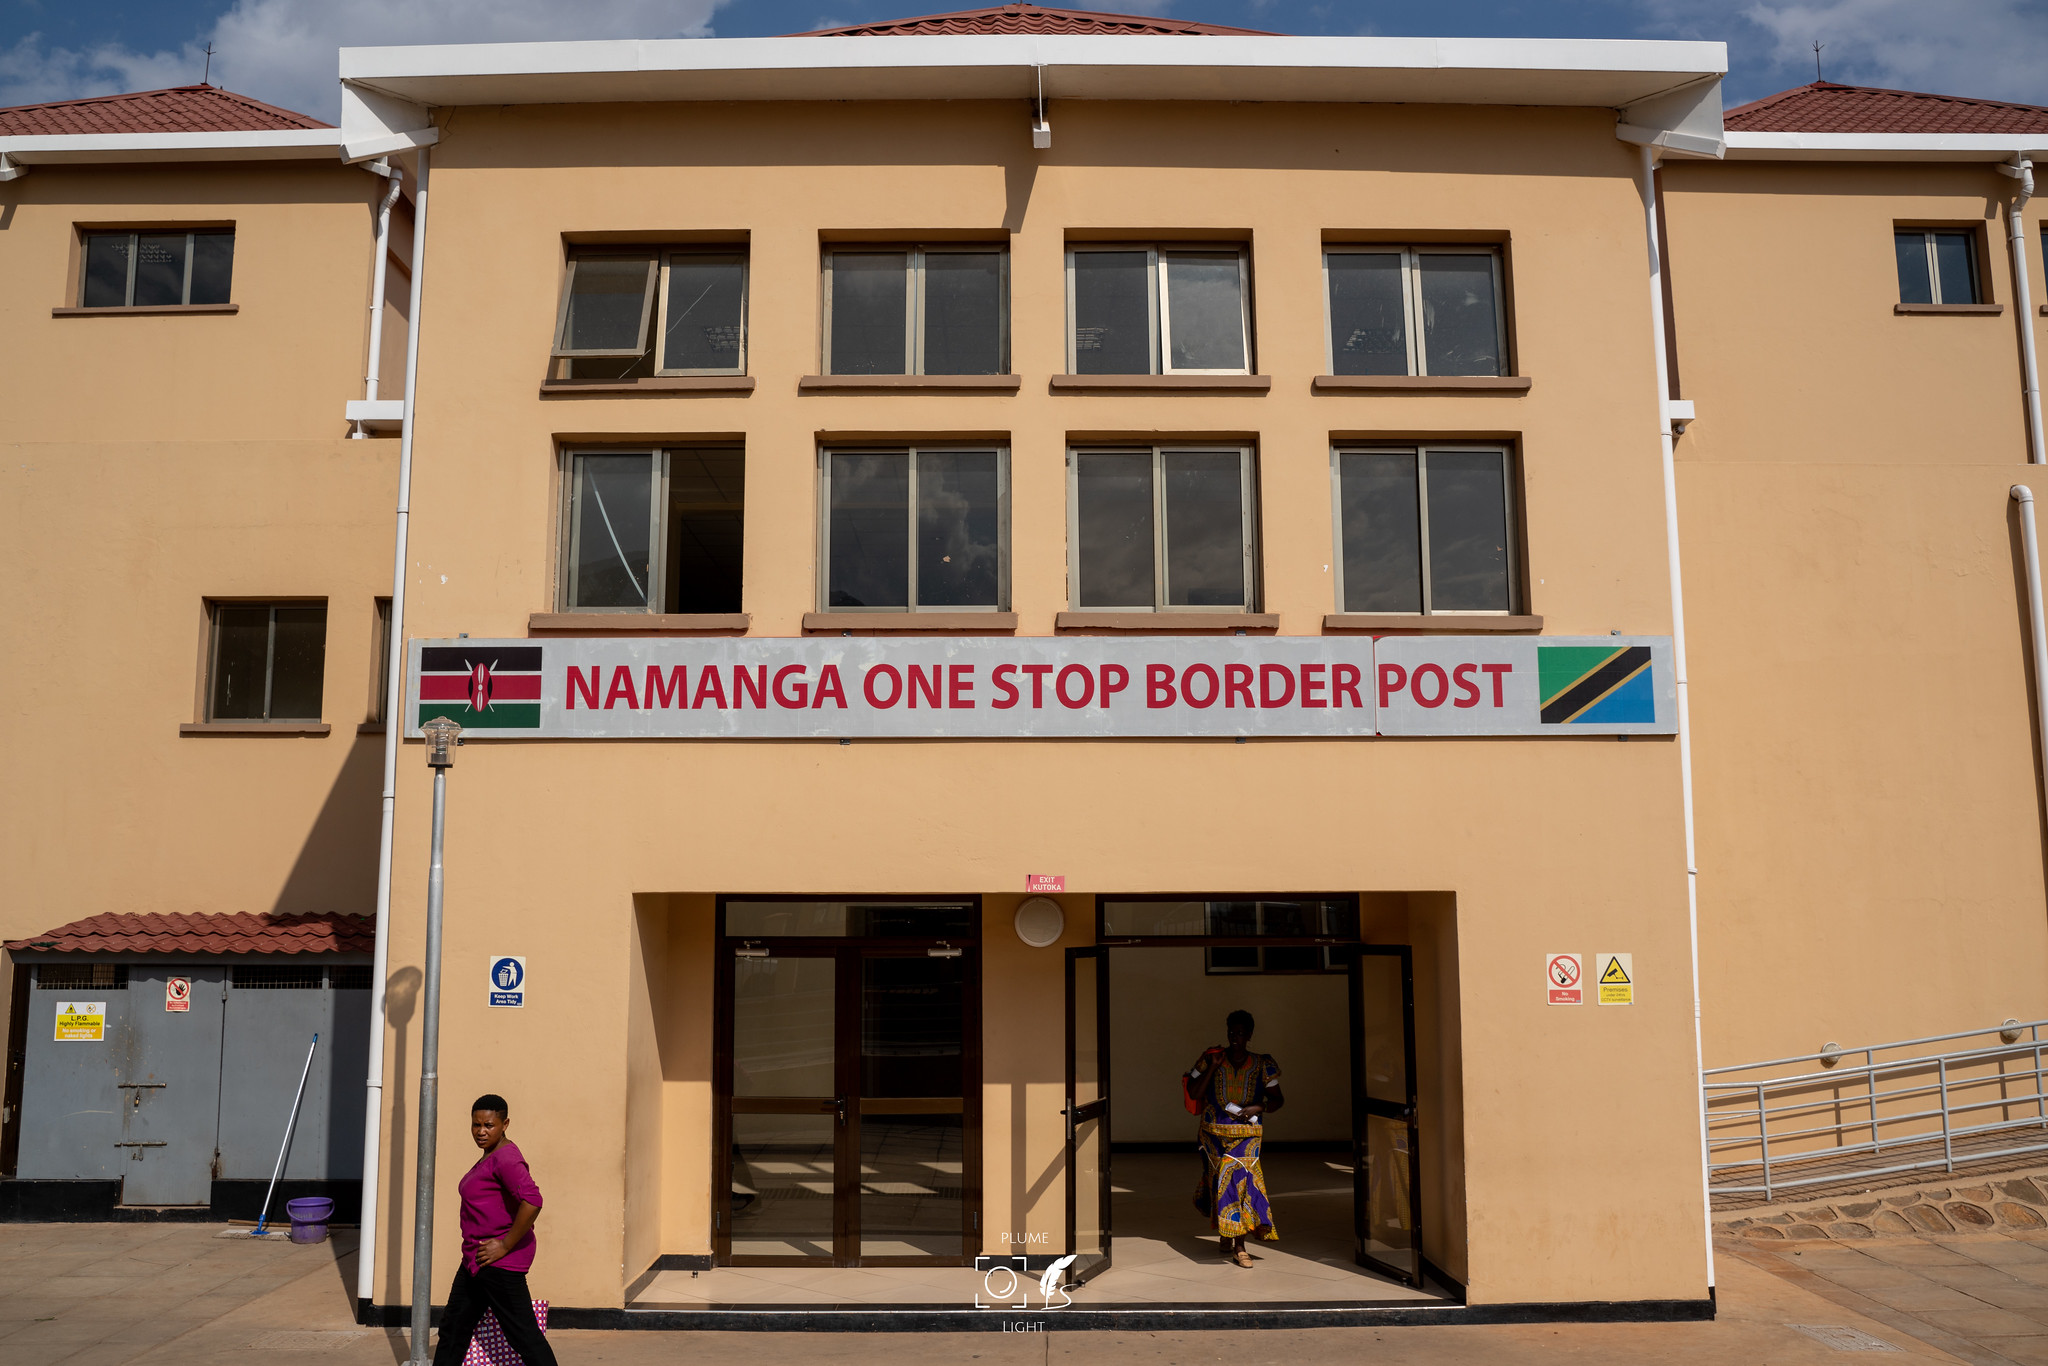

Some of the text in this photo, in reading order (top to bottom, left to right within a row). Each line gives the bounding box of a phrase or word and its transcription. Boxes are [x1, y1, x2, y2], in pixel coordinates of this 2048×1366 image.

[566, 663, 1513, 710] NAMANGA ONE STOP BORDER POST
